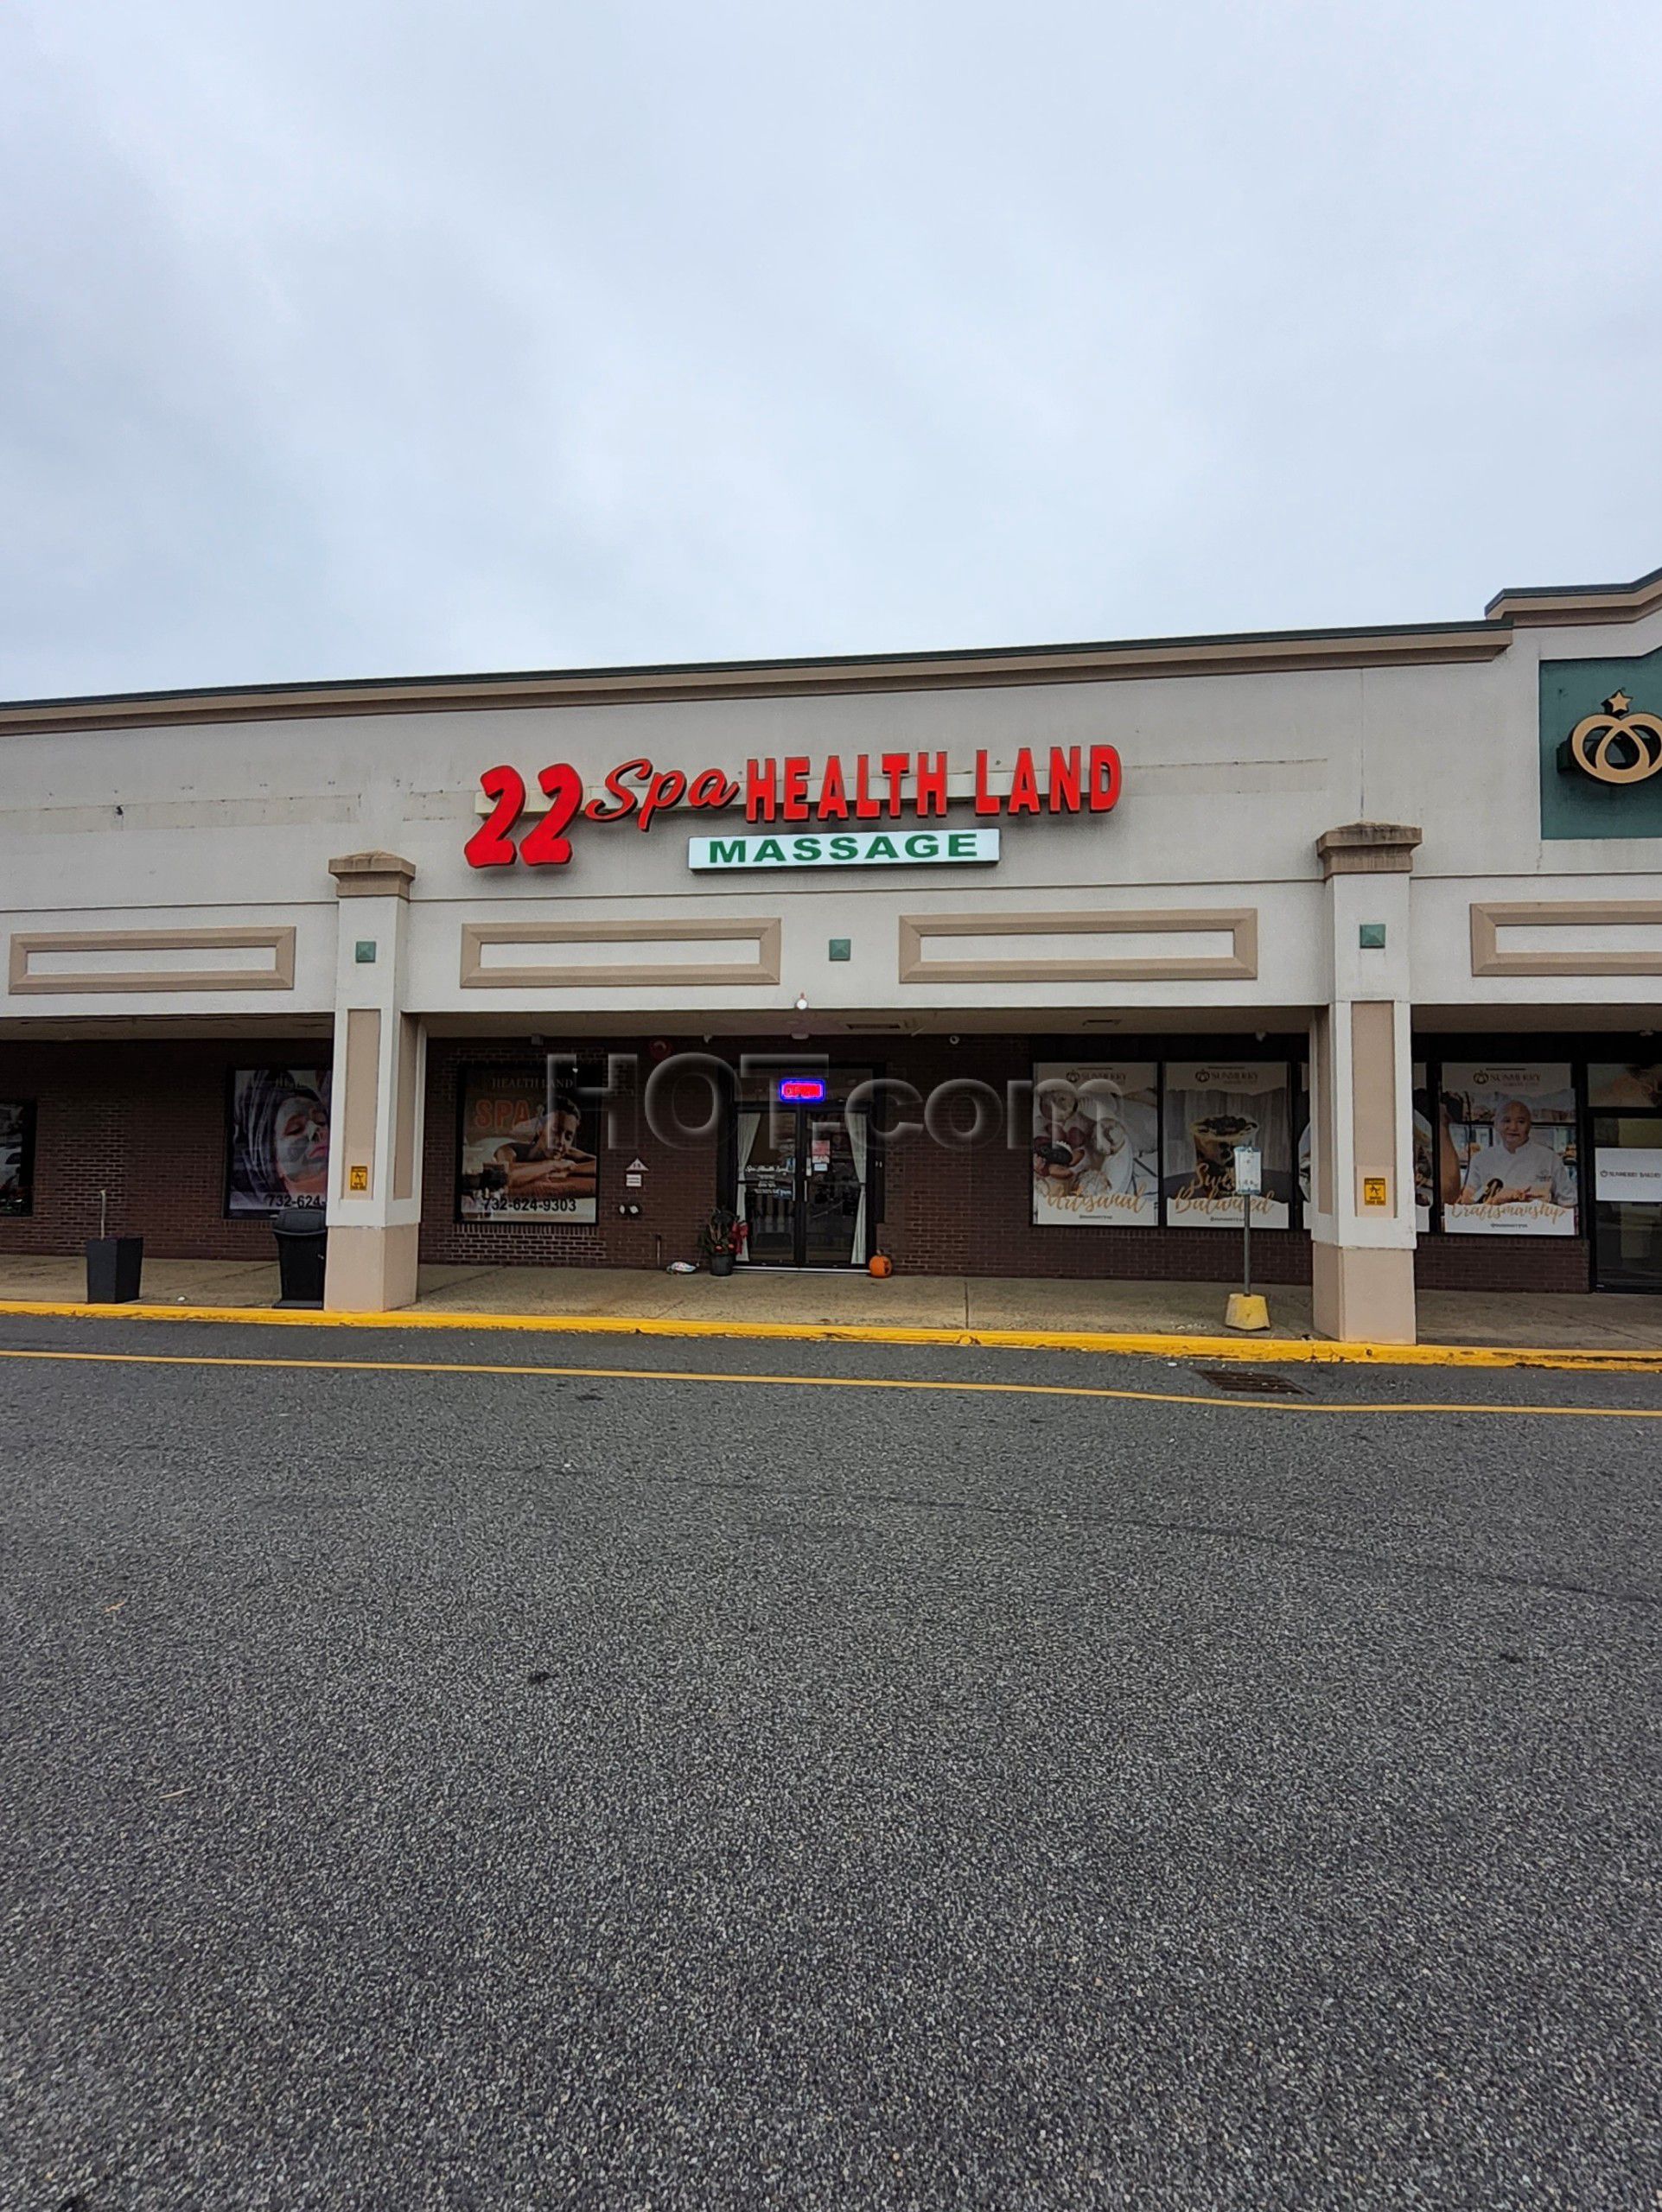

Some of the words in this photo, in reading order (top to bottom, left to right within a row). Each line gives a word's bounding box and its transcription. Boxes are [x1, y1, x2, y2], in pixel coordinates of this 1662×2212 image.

[464, 763, 583, 868] 22
[585, 759, 739, 831] Spa
[745, 752, 947, 823] HEALTH
[975, 745, 1122, 817] LAND
[709, 833, 977, 863] MASSAGE
[475, 1099, 532, 1128] SPA
[483, 1198, 576, 1212] 732-624-9303
